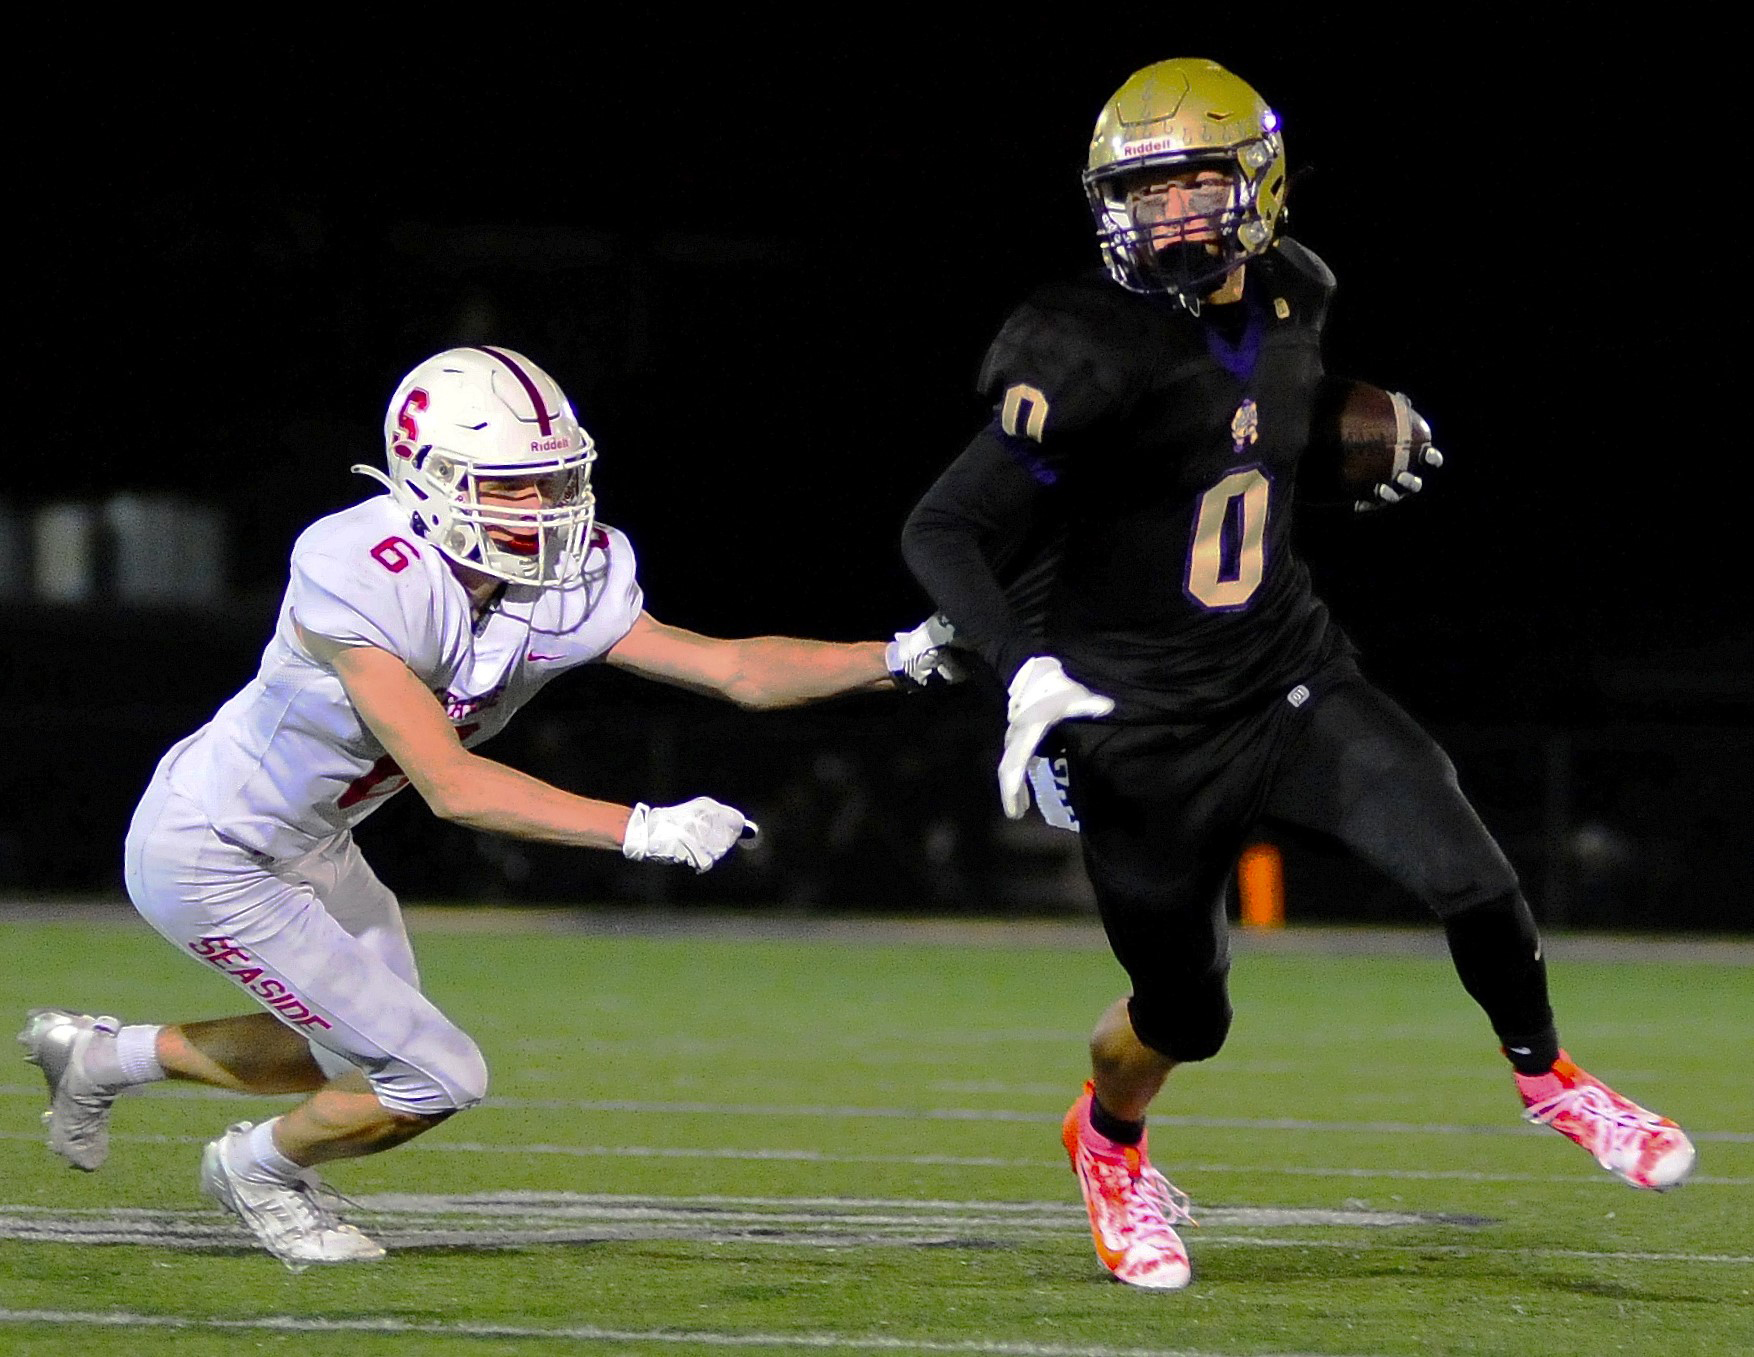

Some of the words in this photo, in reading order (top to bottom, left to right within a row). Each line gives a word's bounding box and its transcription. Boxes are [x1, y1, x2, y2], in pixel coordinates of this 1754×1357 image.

[1124, 139, 1171, 156] Riddell
[393, 387, 430, 459] S
[530, 438, 570, 452] Riddell
[370, 536, 421, 573] 6
[1183, 463, 1272, 612] 0
[189, 936, 332, 1032] SEASIDE
